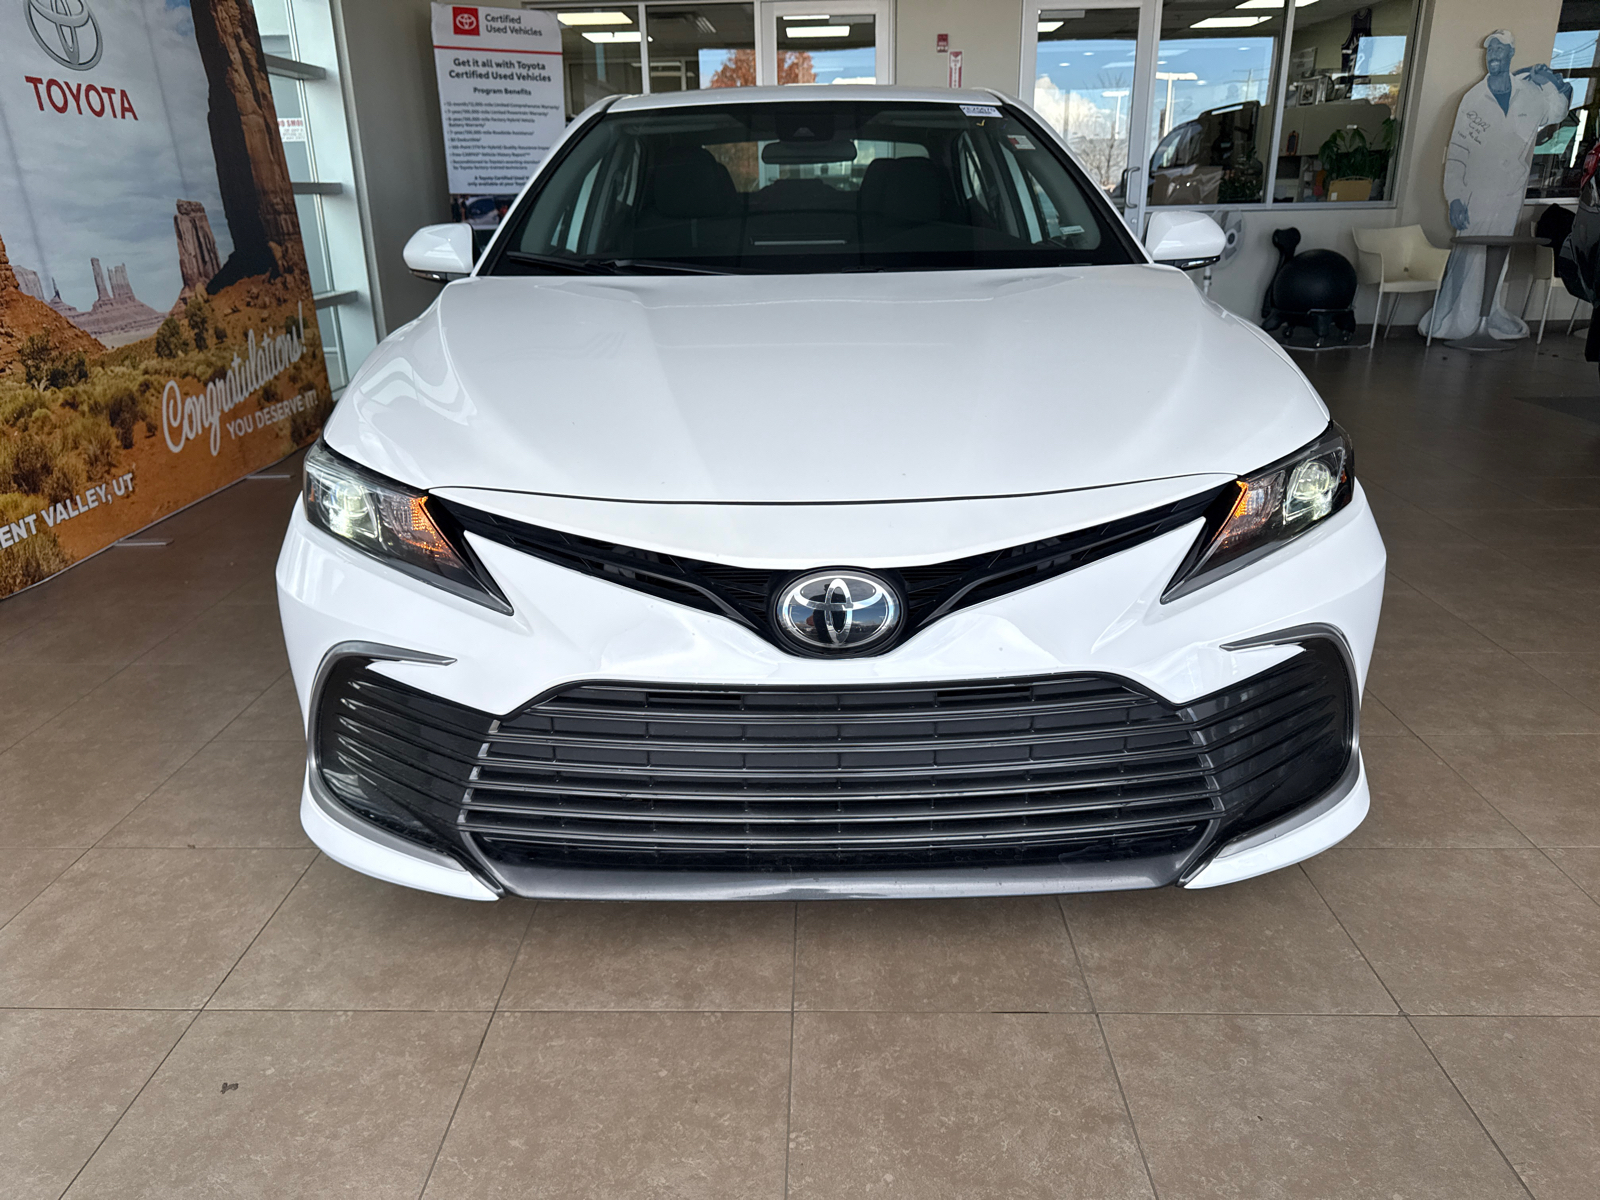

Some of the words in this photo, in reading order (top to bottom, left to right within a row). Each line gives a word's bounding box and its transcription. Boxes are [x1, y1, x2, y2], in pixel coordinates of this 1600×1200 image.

[484, 13, 521, 24] Certified
[485, 24, 508, 34] Used
[509, 26, 543, 37] Vehicles
[453, 58, 472, 67] Get
[472, 58, 480, 68] it
[481, 58, 493, 69] all
[495, 59, 515, 70] with
[517, 60, 546, 72] Toyota
[448, 69, 490, 80] Certified
[491, 71, 514, 81] Used
[515, 72, 552, 83] Vehicles
[24, 75, 139, 121] TOYOTA
[473, 86, 503, 97] Program
[504, 87, 532, 96] Benefits
[162, 300, 307, 457] Congratulations!
[226, 413, 253, 440] YOU
[255, 395, 304, 429] DESERVE
[304, 389, 319, 407] IT!
[0, 513, 37, 550] ENT
[41, 483, 113, 528] VALLEY,
[112, 472, 133, 496] UT
